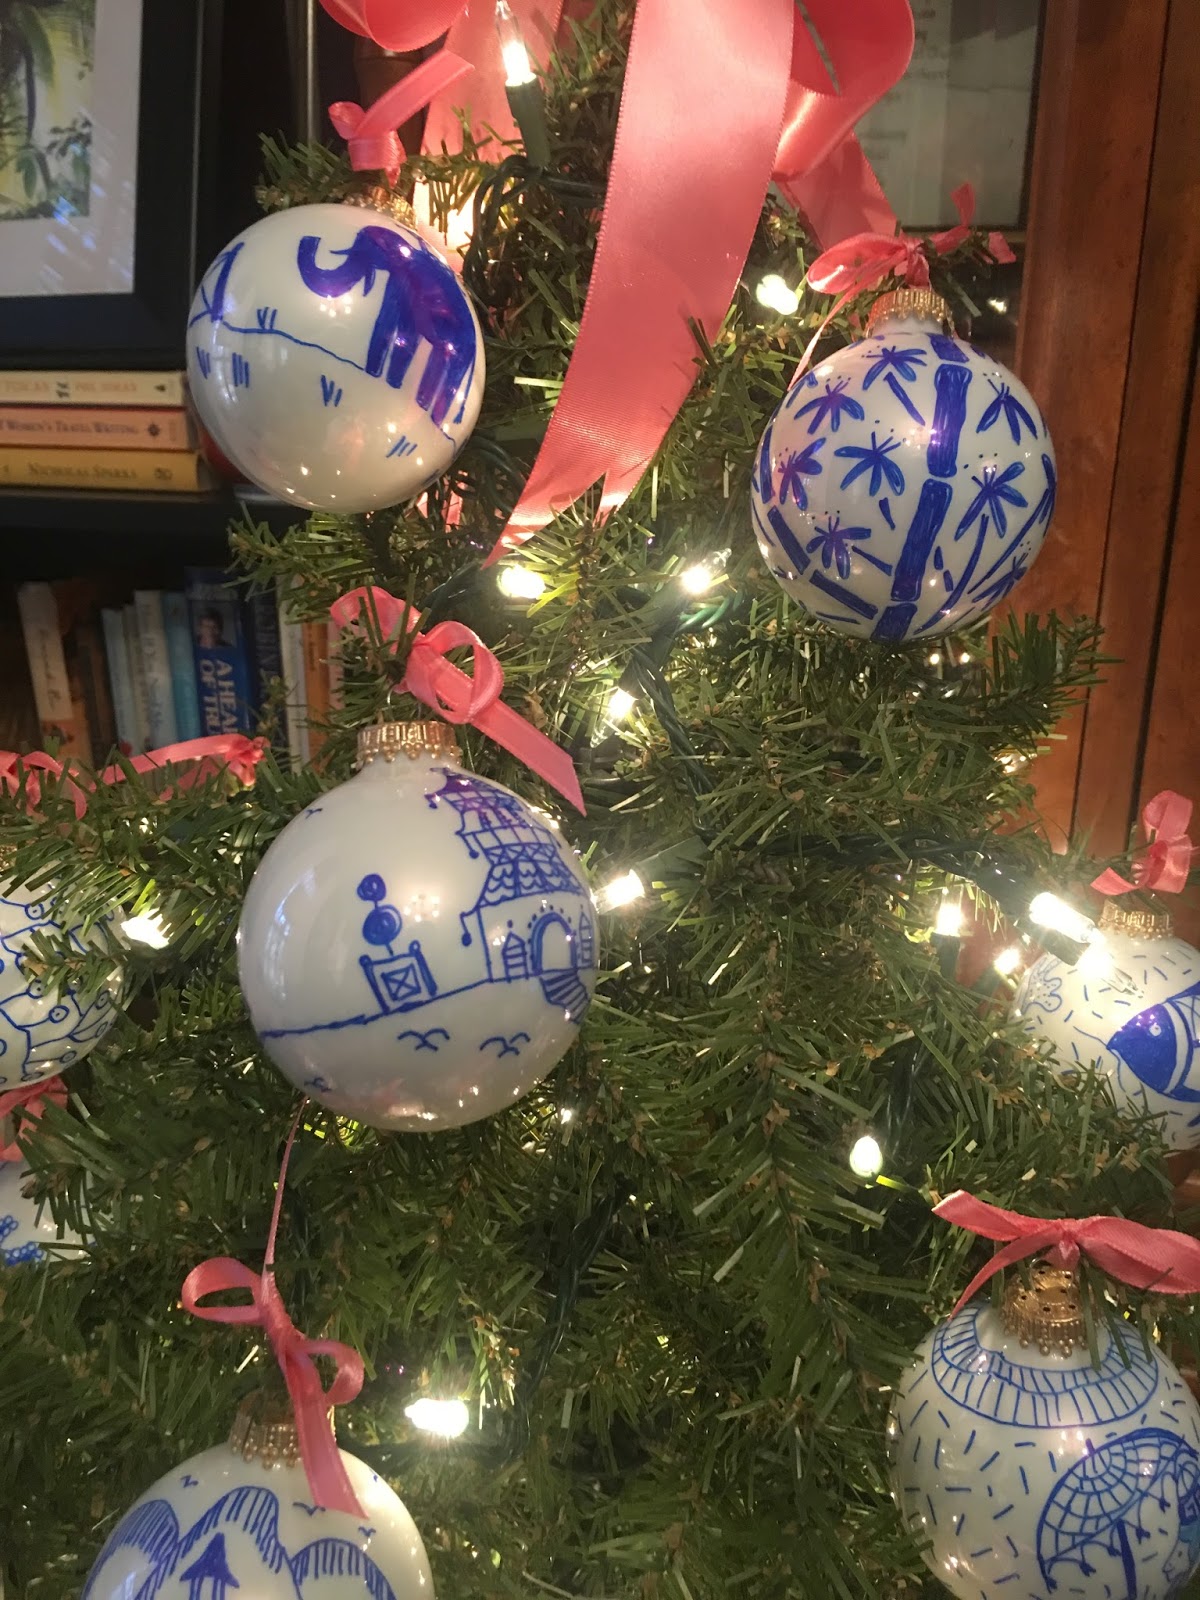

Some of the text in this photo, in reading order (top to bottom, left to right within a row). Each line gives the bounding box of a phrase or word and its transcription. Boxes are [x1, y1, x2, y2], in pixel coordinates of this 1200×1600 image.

[27, 462, 89, 478] NICHOLAS
[92, 463, 138, 480] SPARKS
[200, 659, 217, 689] OF
[216, 659, 233, 677] A
